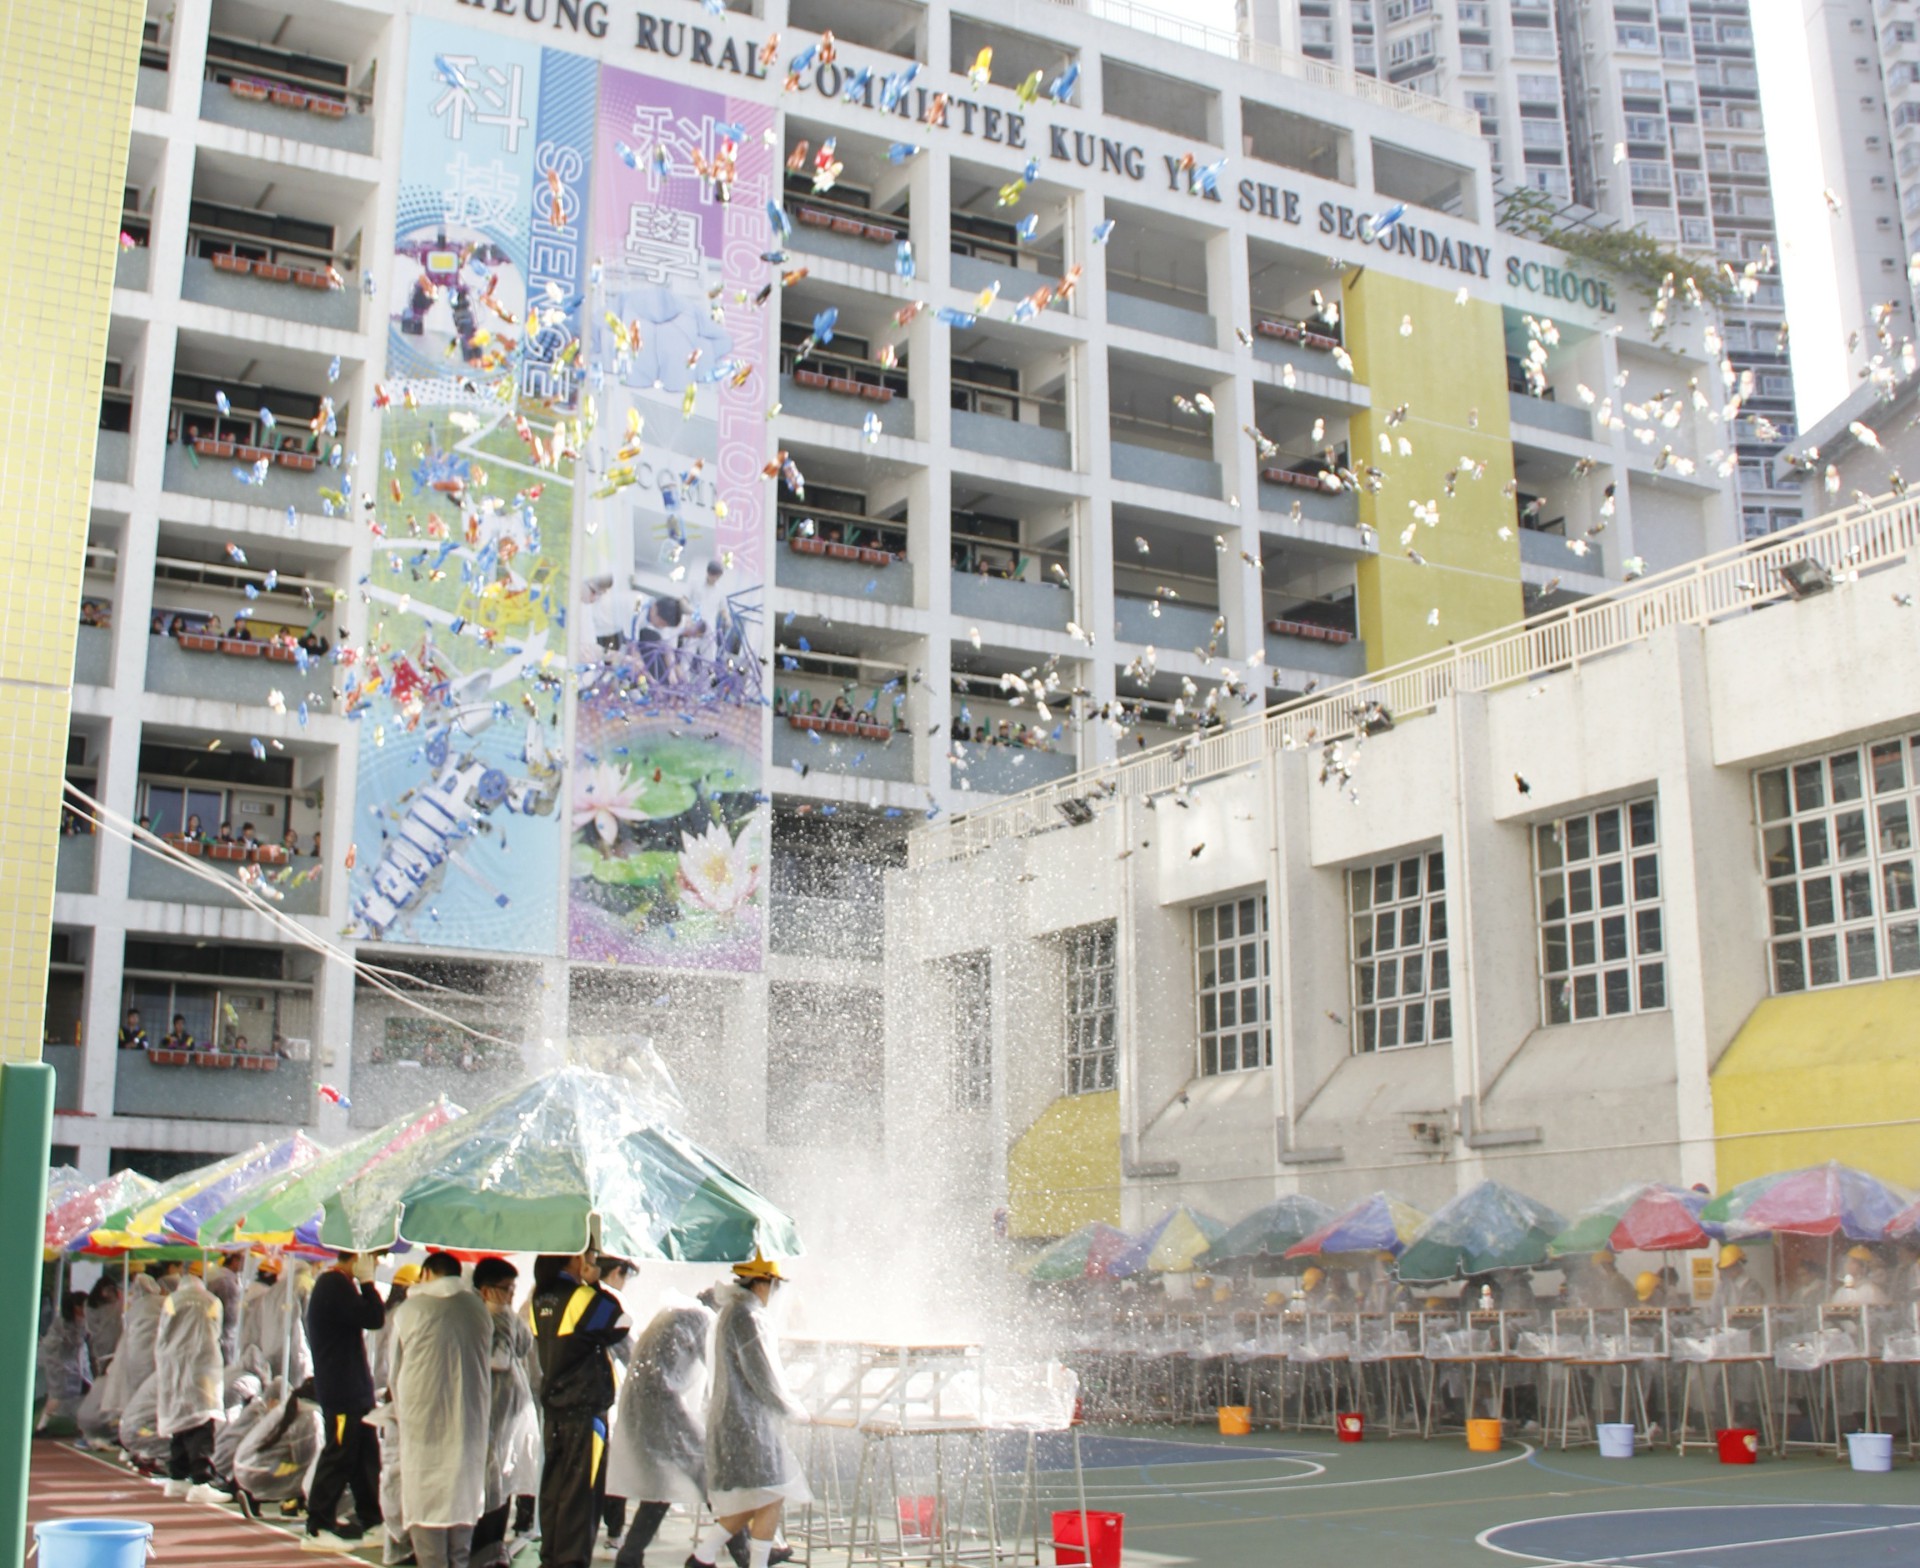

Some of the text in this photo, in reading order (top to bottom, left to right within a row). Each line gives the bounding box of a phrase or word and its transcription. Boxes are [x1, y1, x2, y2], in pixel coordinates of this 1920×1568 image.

[456, 0, 609, 38] UNG
[635, 12, 767, 80] RURAL
[1049, 124, 1145, 180] KUNG
[1238, 178, 1301, 225] SHE
[1319, 202, 1492, 279] SECONDARY
[1506, 256, 1616, 314] SCHOOL
[523, 141, 583, 403] SCIENCE
[625, 105, 715, 285] 科學
[717, 172, 769, 578] TECHNOLOGY
